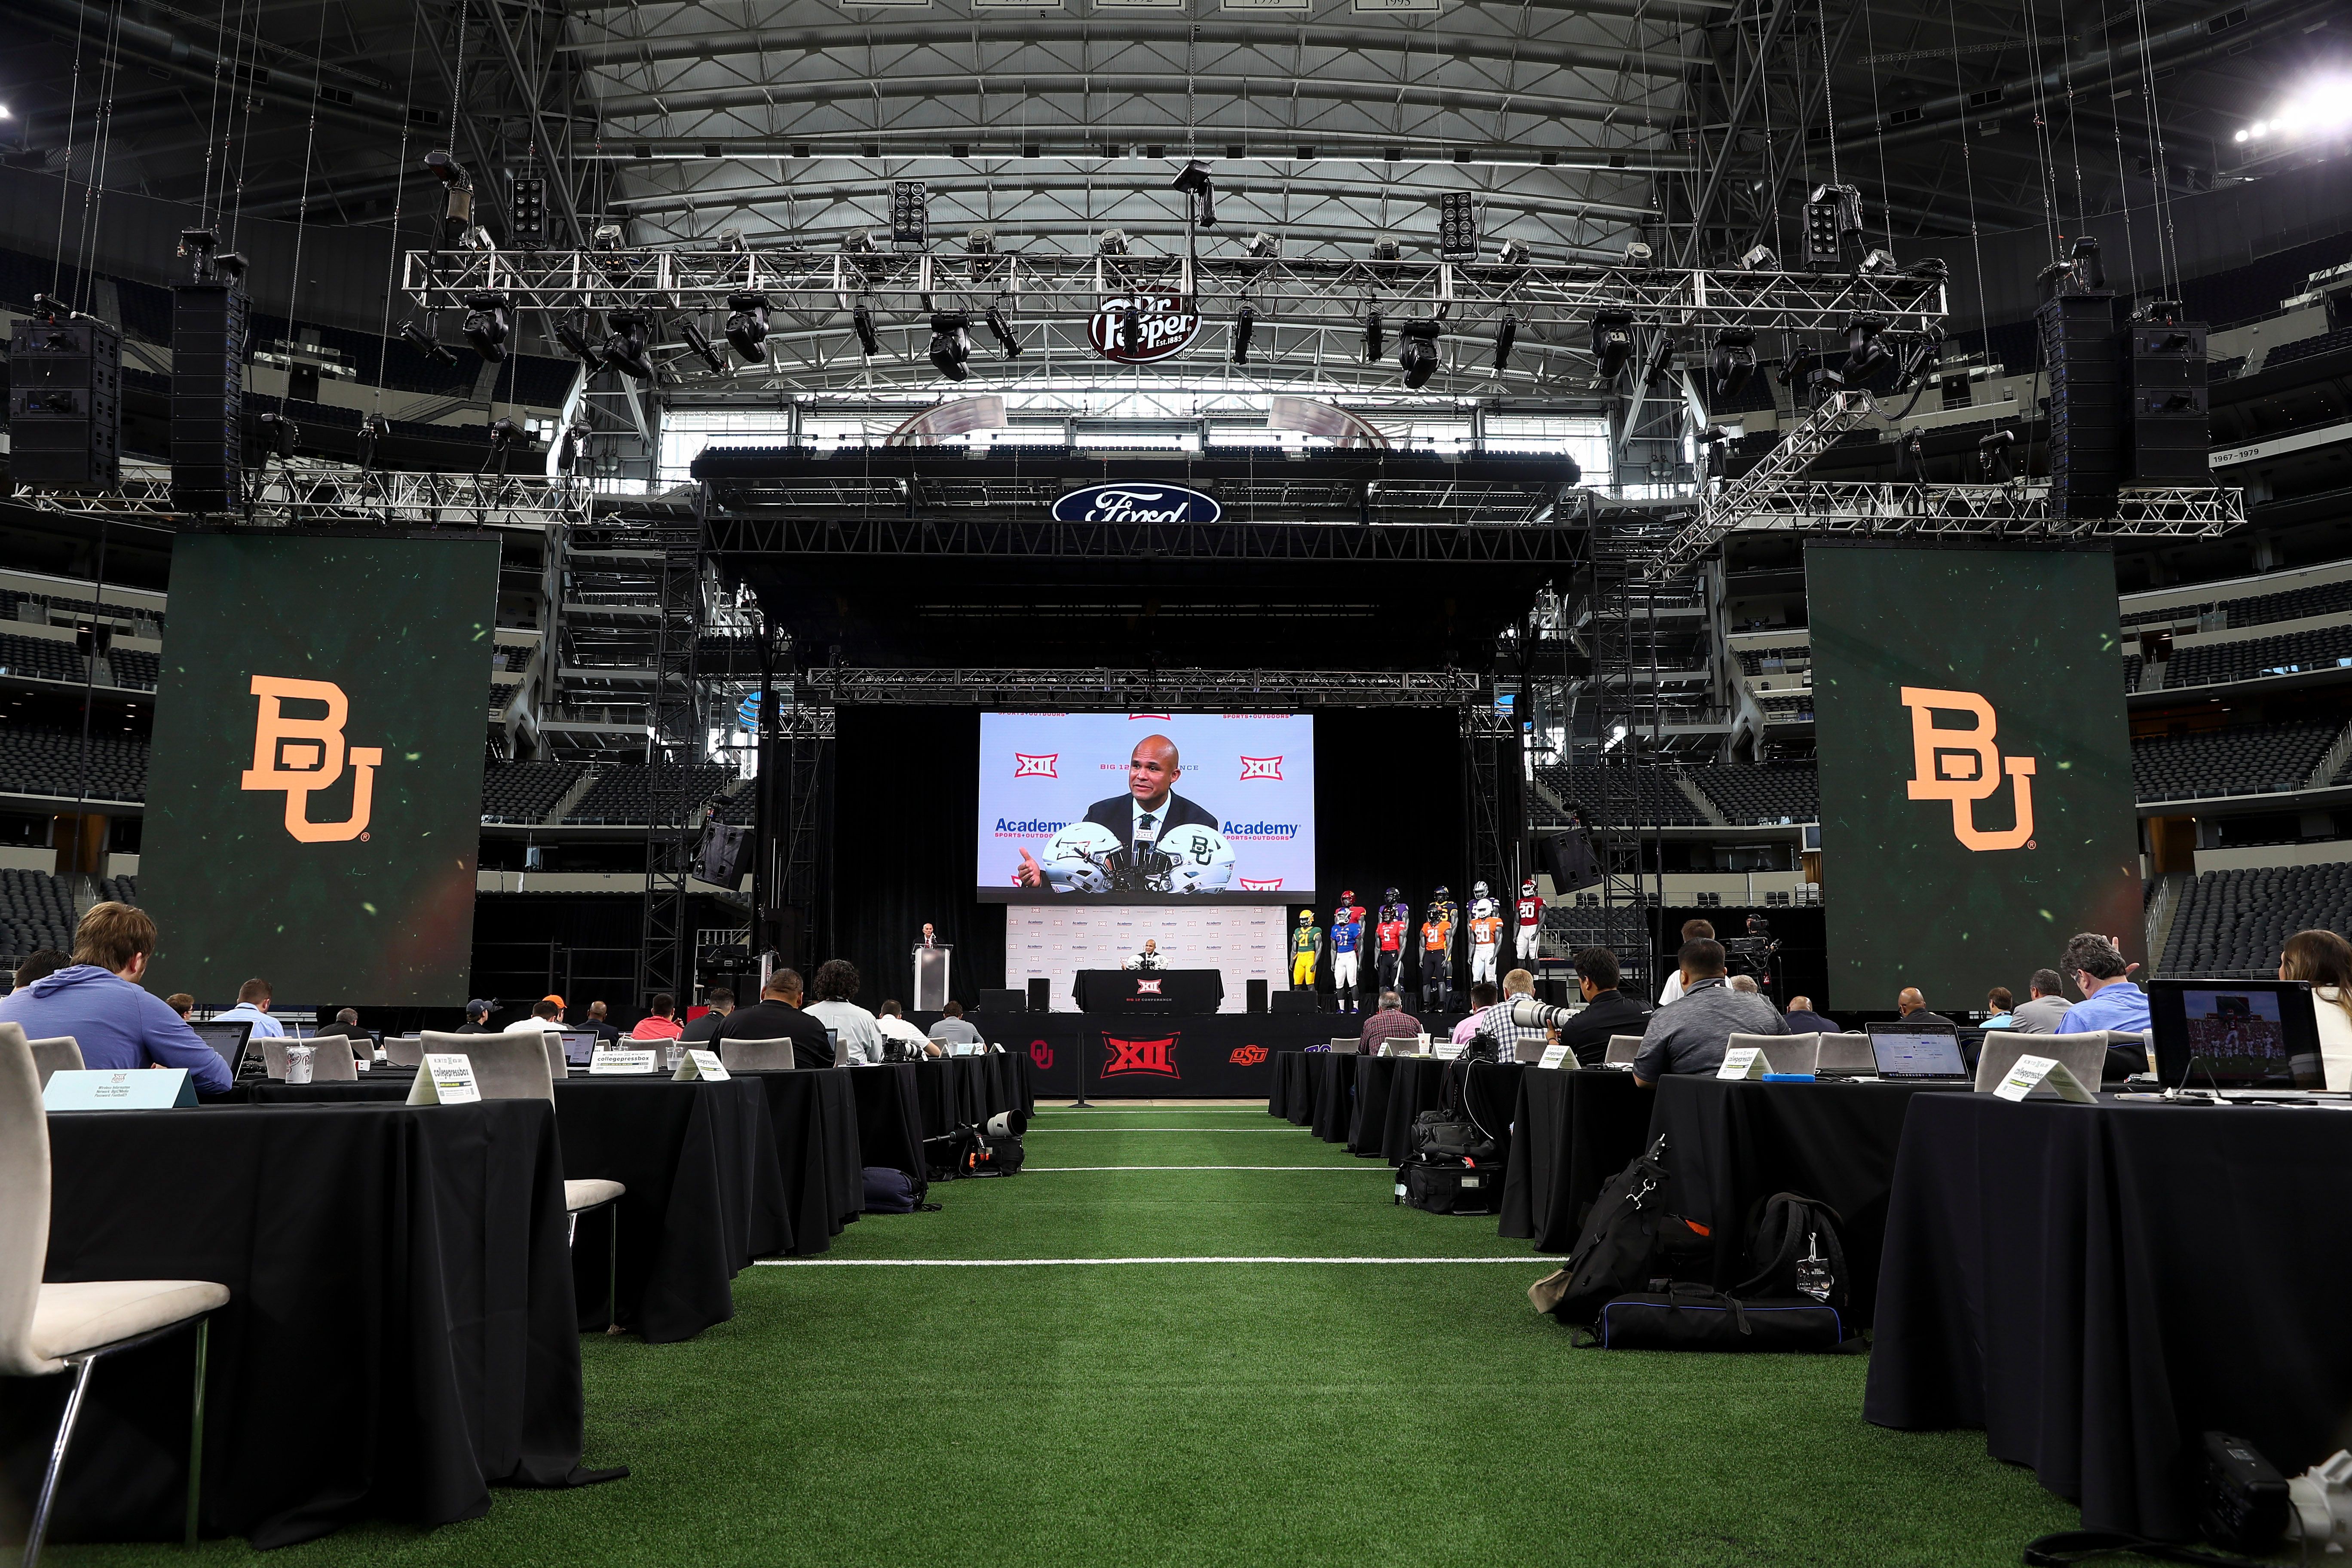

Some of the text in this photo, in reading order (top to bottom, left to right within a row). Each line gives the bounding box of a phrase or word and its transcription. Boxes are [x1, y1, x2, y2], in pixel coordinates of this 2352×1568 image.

[1156, 335, 1182, 347] Est.1885
[241, 675, 382, 843] BU
[1016, 753, 1057, 778] XII
[1241, 756, 1282, 780] XII
[1901, 686, 2036, 851] BU
[1222, 821, 1298, 839] Academy
[1190, 835, 1214, 866] BU
[1519, 905, 1534, 918] 20
[1298, 934, 1309, 947] 21
[1383, 929, 1390, 942] 5
[1427, 929, 1438, 943] 21
[1474, 928, 1490, 943] 60
[1138, 980, 1161, 993] XII
[1030, 1040, 1054, 1069] OU
[1104, 1035, 1177, 1075] XII
[1230, 1046, 1268, 1065] OSU
[434, 1067, 469, 1079] collegepressbox
